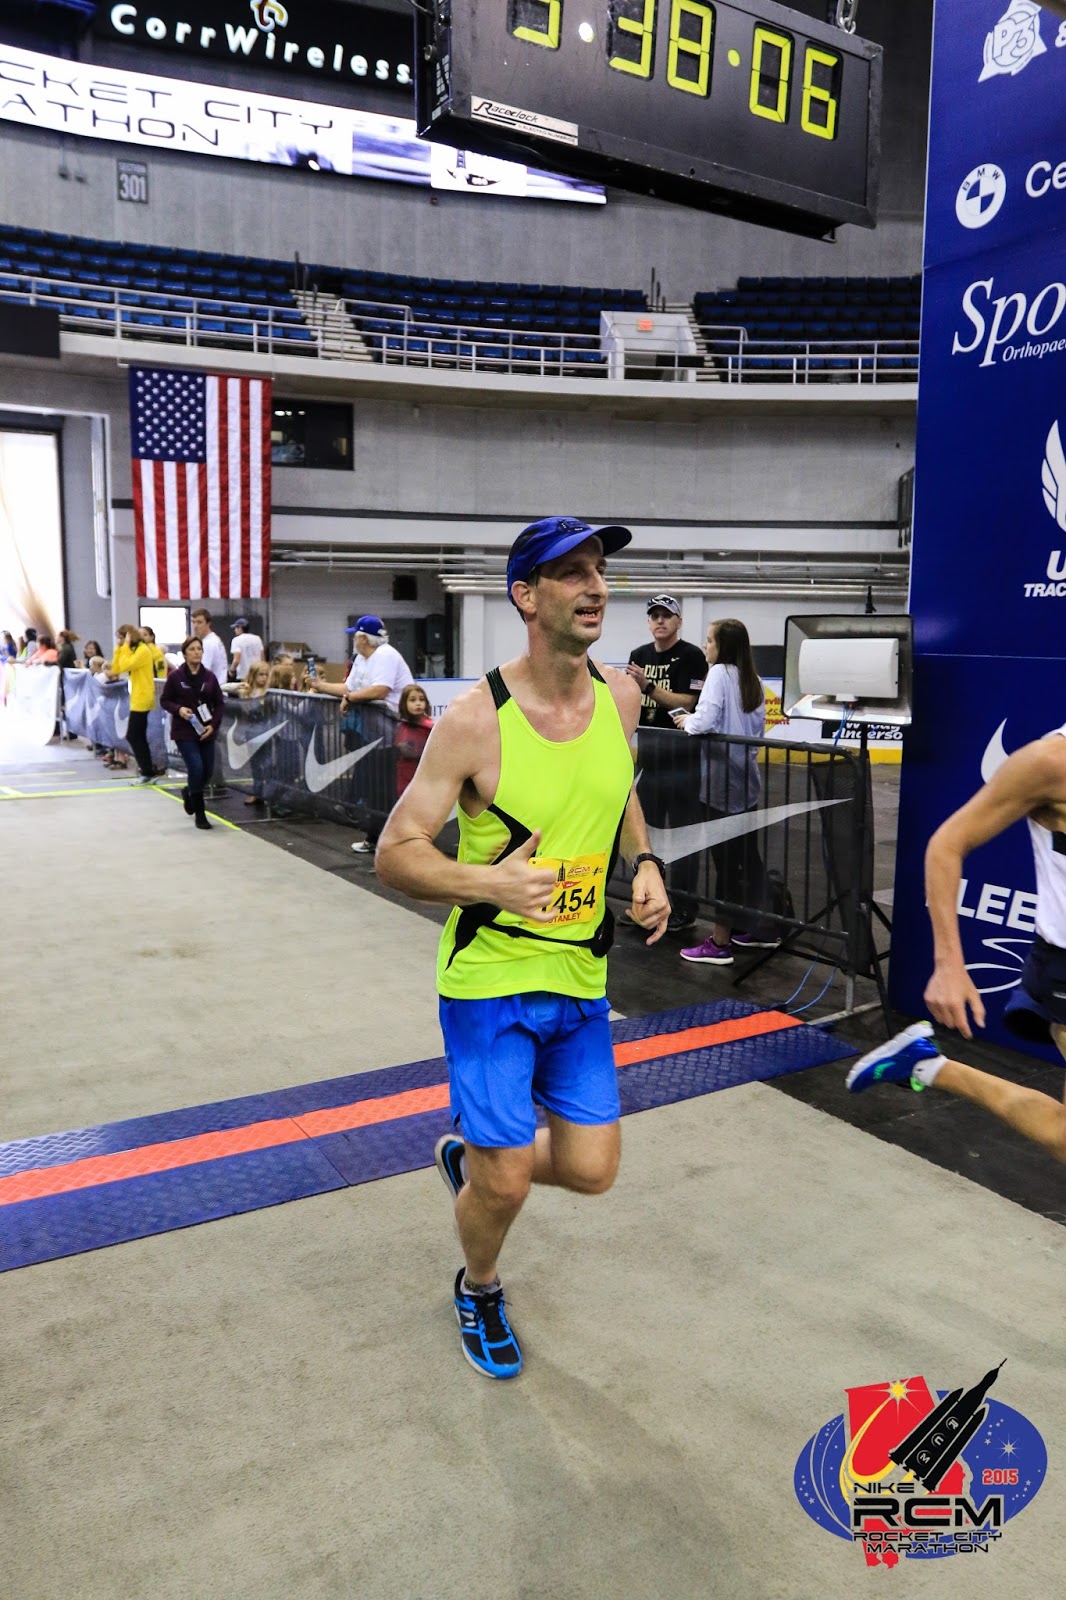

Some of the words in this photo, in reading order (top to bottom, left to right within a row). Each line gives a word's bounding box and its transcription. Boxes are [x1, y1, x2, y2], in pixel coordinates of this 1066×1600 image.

[110, 3, 411, 85] CorrWireless
[204, 100, 333, 135] CITY
[120, 173, 147, 201] 301
[961, 166, 1001, 192] BMW
[951, 277, 1066, 367] Spo
[1002, 338, 1066, 362] Orthopae
[541, 885, 596, 914] 454
[925, 878, 1039, 933] LEE
